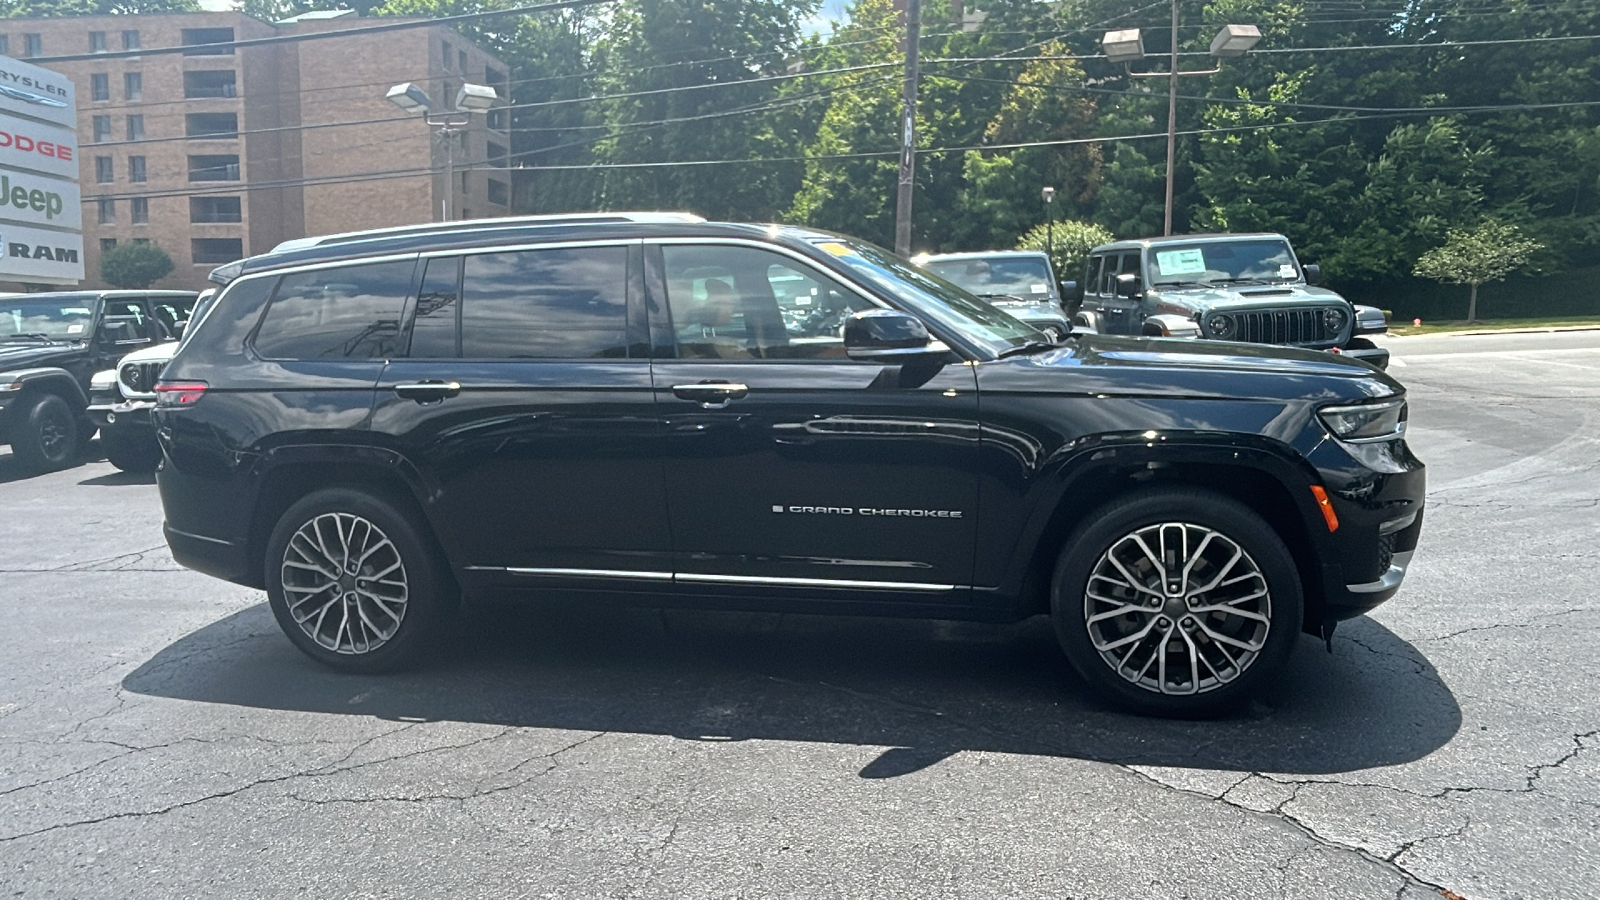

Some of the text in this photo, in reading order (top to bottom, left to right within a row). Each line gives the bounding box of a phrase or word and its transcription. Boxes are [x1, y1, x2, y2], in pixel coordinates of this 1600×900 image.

[0, 175, 63, 220] Jeep
[8, 242, 79, 264] RAM
[789, 505, 963, 518] GRAND CHEROKEE
